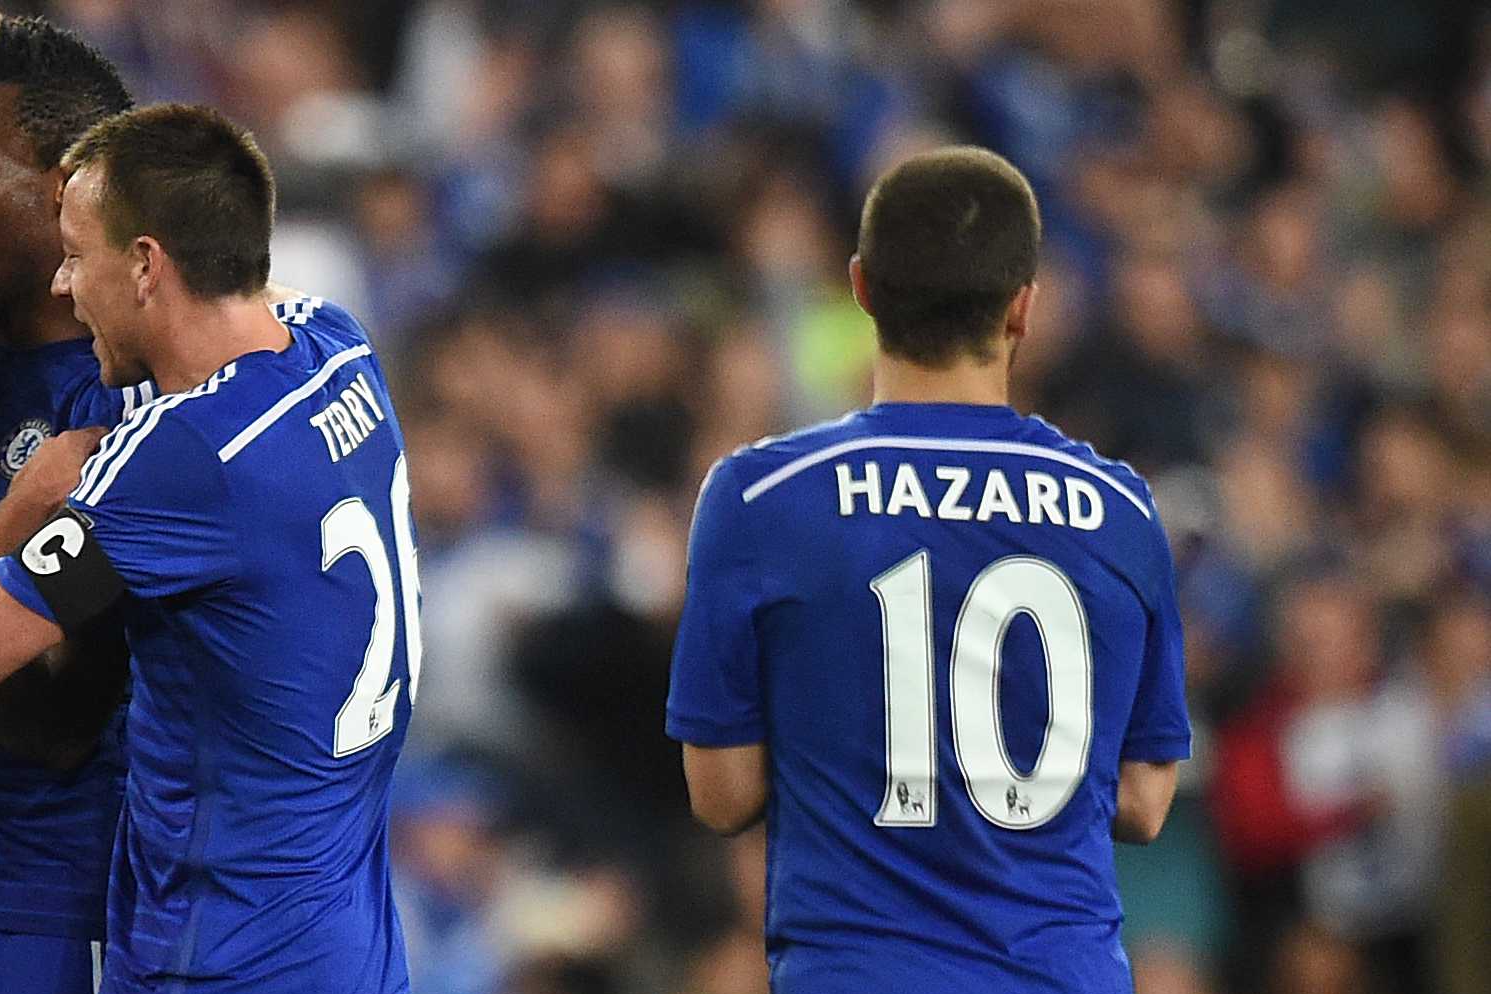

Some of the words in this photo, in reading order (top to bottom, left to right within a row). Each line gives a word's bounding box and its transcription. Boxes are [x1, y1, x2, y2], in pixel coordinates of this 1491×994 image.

[309, 372, 385, 463] TERRY
[835, 462, 1104, 532] HAZARD
[21, 516, 85, 575] C
[869, 548, 1094, 830] 10
